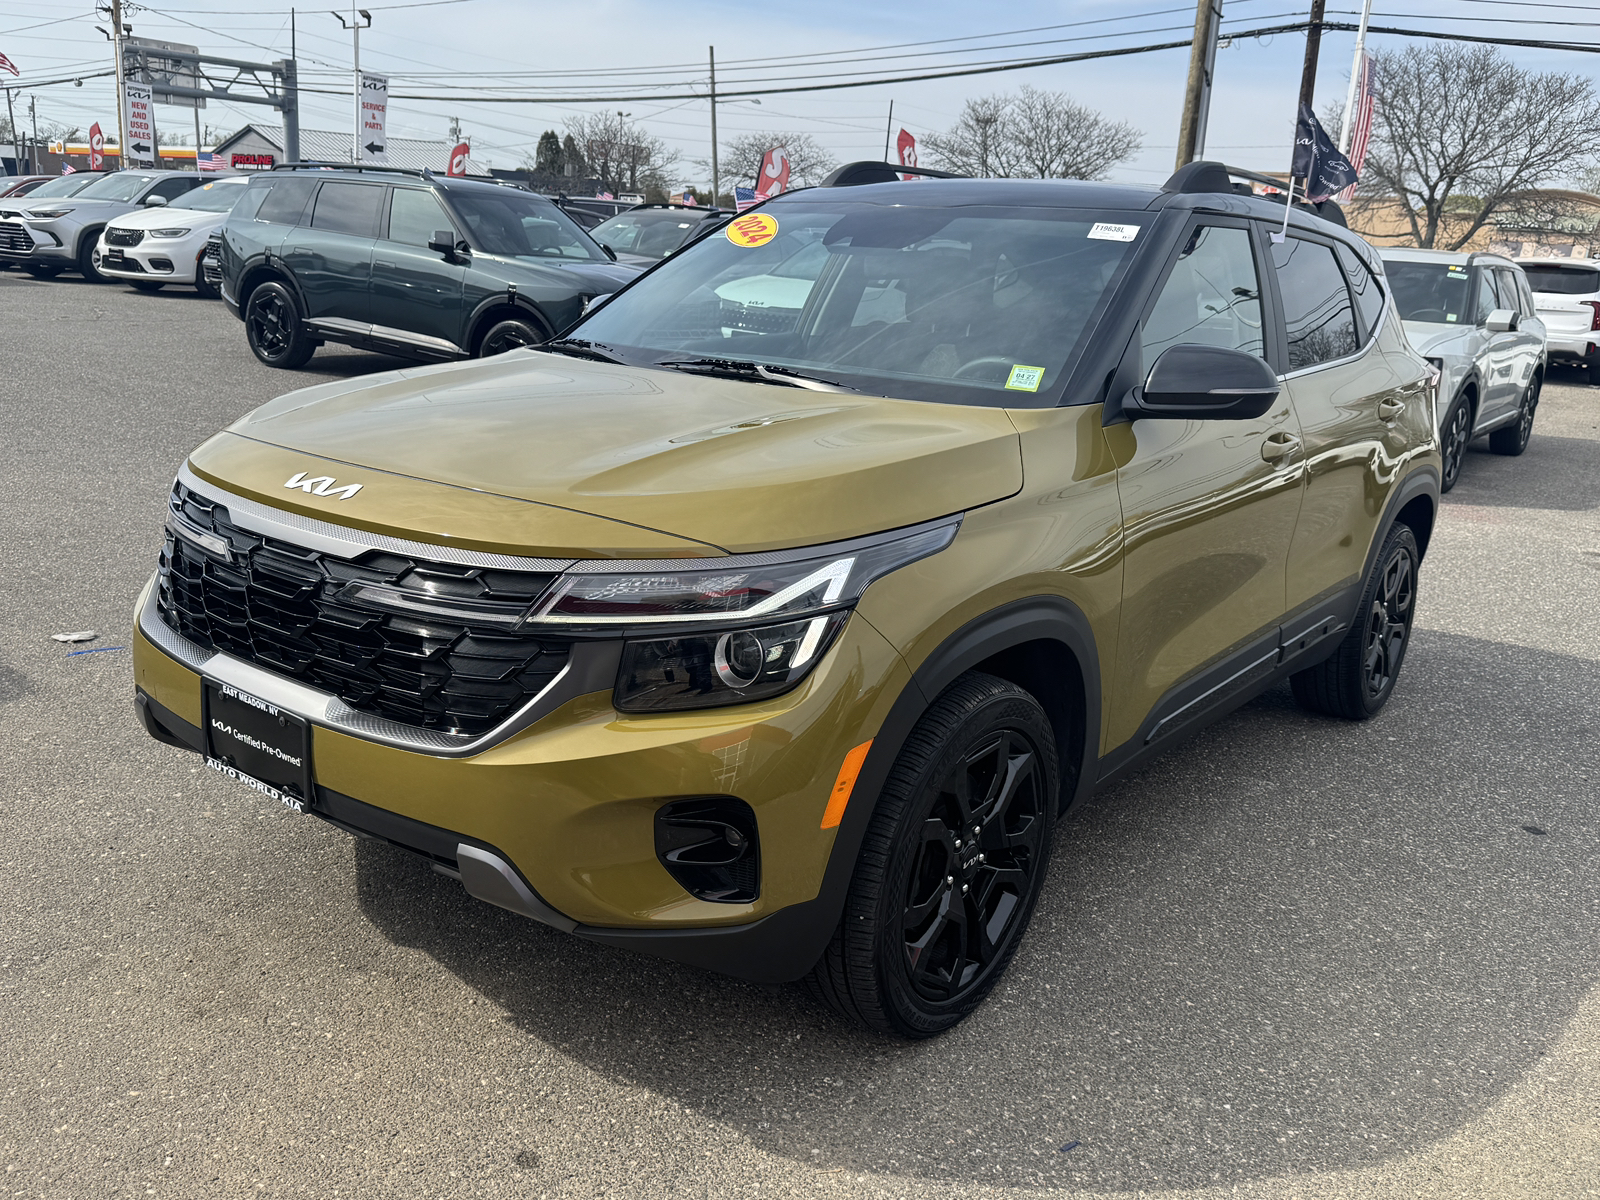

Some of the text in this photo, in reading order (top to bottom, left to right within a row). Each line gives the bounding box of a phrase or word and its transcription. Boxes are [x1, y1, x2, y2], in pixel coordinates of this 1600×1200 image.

[363, 75, 387, 84] AUTOWORLD
[127, 85, 150, 93] AUTOWORLD
[131, 101, 148, 110] NEW
[362, 101, 386, 112] SERVICE
[132, 111, 147, 120] AND
[130, 121, 149, 130] USED
[364, 121, 383, 130] PARTS
[128, 130, 151, 140] SALES
[231, 153, 274, 167] PROLINE
[733, 216, 772, 243] 2024
[283, 471, 364, 501] KIA
[222, 685, 237, 699] EAST
[269, 705, 279, 717] NY
[212, 718, 232, 734] KIA
[233, 729, 261, 749] Certified
[207, 759, 302, 812] AUTO WORLD KIA
